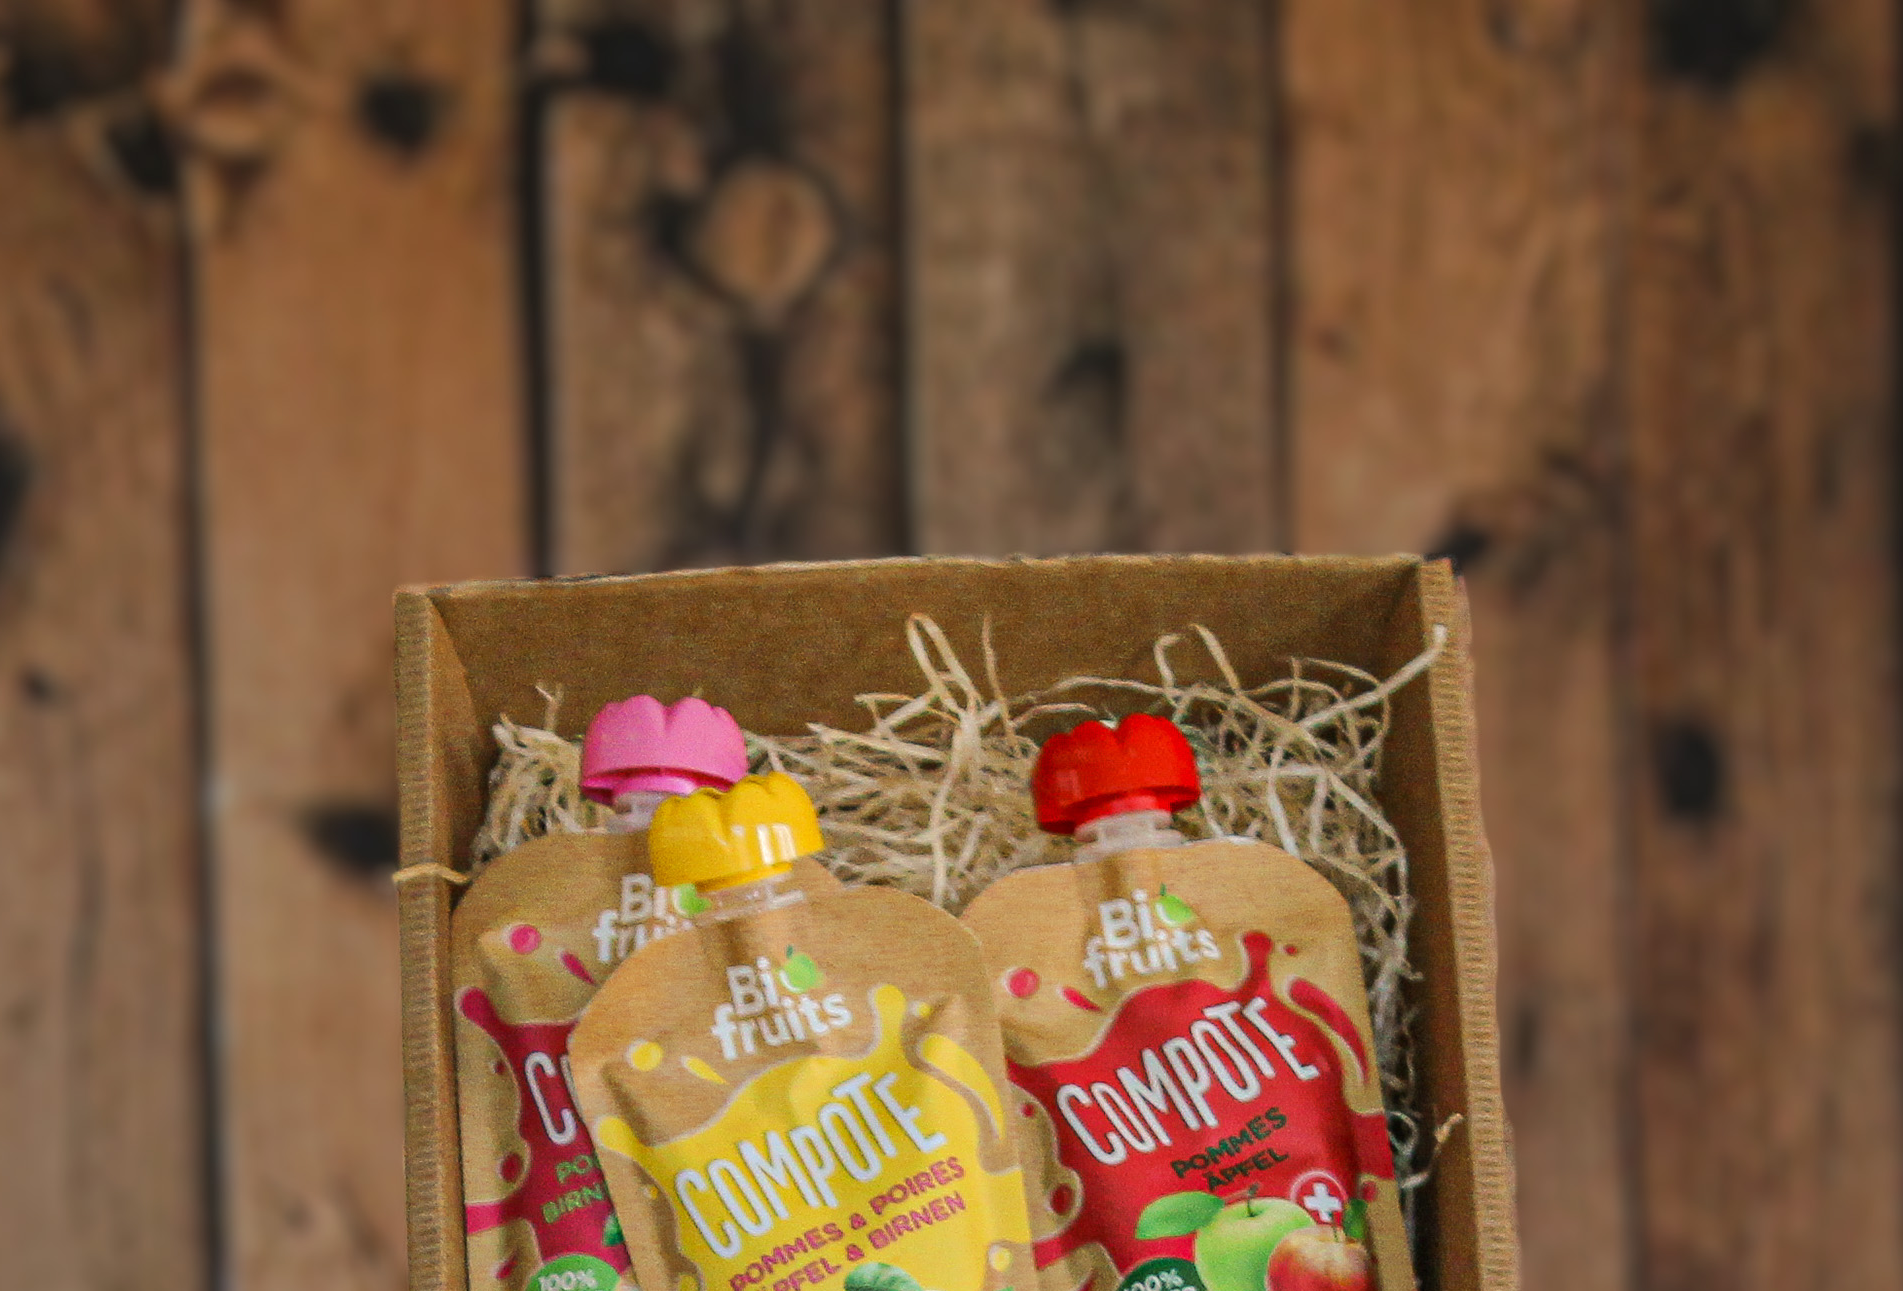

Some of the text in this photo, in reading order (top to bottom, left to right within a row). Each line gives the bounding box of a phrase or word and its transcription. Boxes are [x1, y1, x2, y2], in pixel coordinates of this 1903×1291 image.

[1083, 928, 1223, 990] fruits
[711, 992, 854, 1062] fruits
[1055, 996, 1321, 1166] COMPOTE
[674, 1071, 948, 1259] COMPOTE
[1171, 1106, 1288, 1180] POMMES
[866, 1189, 966, 1251] BIRNEN
[868, 1155, 966, 1216] POIRES
